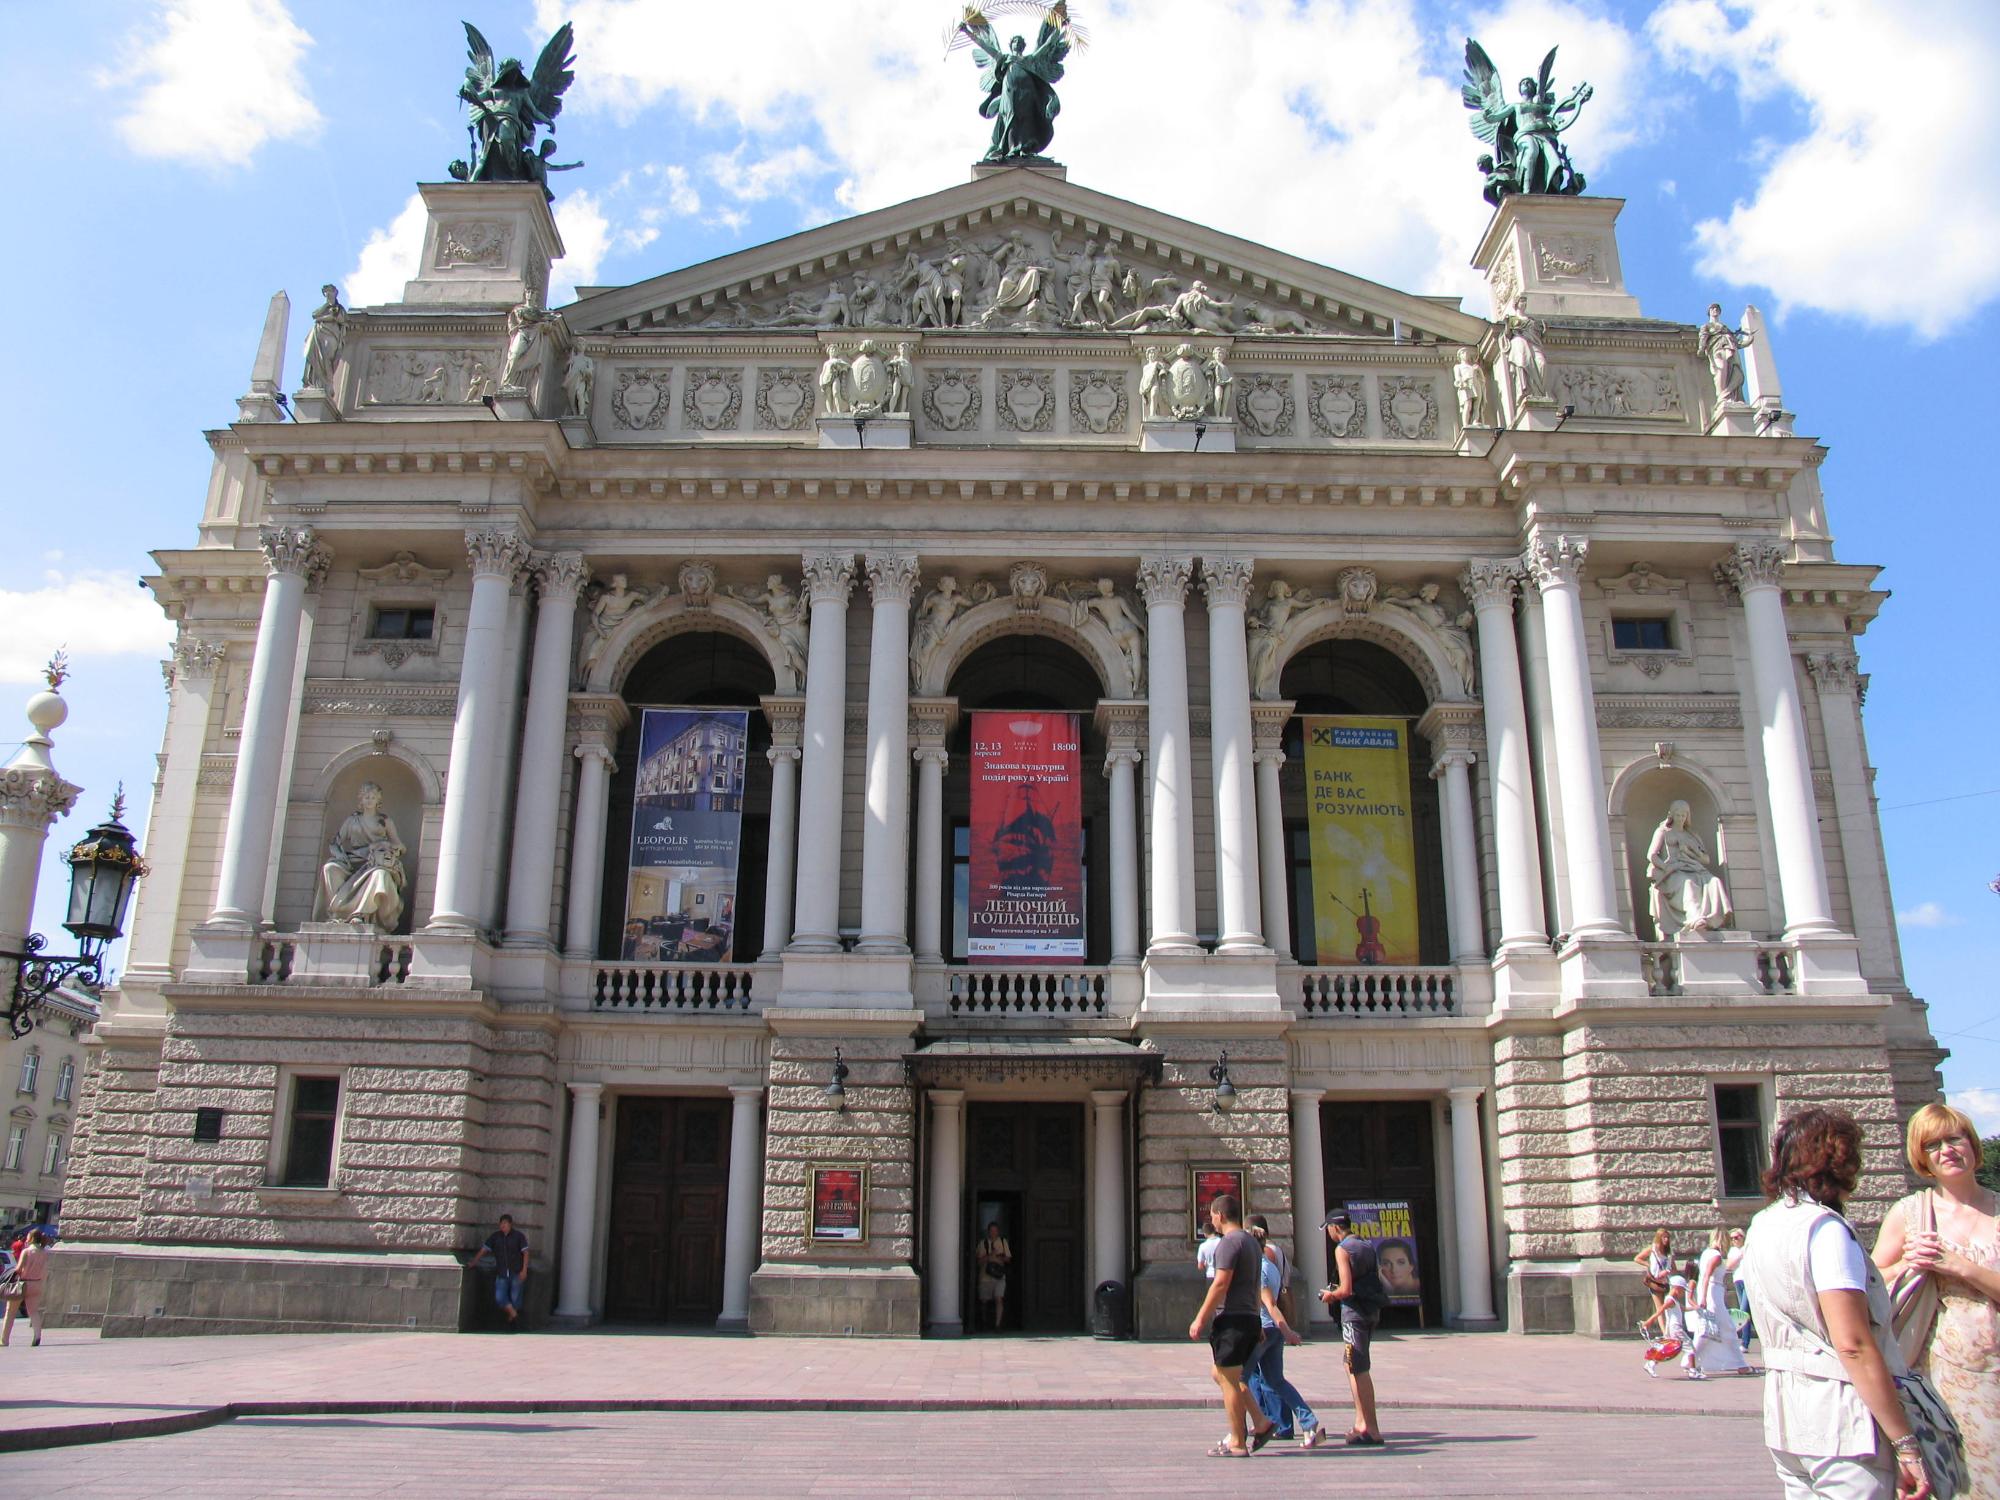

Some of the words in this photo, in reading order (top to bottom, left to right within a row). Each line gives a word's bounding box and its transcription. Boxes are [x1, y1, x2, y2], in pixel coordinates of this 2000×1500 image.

[975, 743, 988, 751] 12,
[1052, 743, 1077, 751] 18:00
[1336, 737, 1360, 745] БАНК
[1363, 738, 1395, 746] АВАЛЬ
[984, 761, 1020, 770] Знакова
[1021, 764, 1065, 773] культурна
[1008, 775, 1029, 783] року
[1036, 774, 1069, 784] Україні
[1314, 770, 1353, 782] БАНК
[1314, 786, 1333, 799] ДЕ
[1337, 787, 1366, 799] ВАС
[1316, 803, 1405, 816] РОЗУМІЮТЬ
[637, 836, 688, 845] LEOPOLIS
[985, 899, 1067, 913] ЛЕТЮЧИЙ
[973, 912, 1080, 927] ГОЛЛАНДЕЦЬ
[1379, 1209, 1410, 1221] ОЛЕНА
